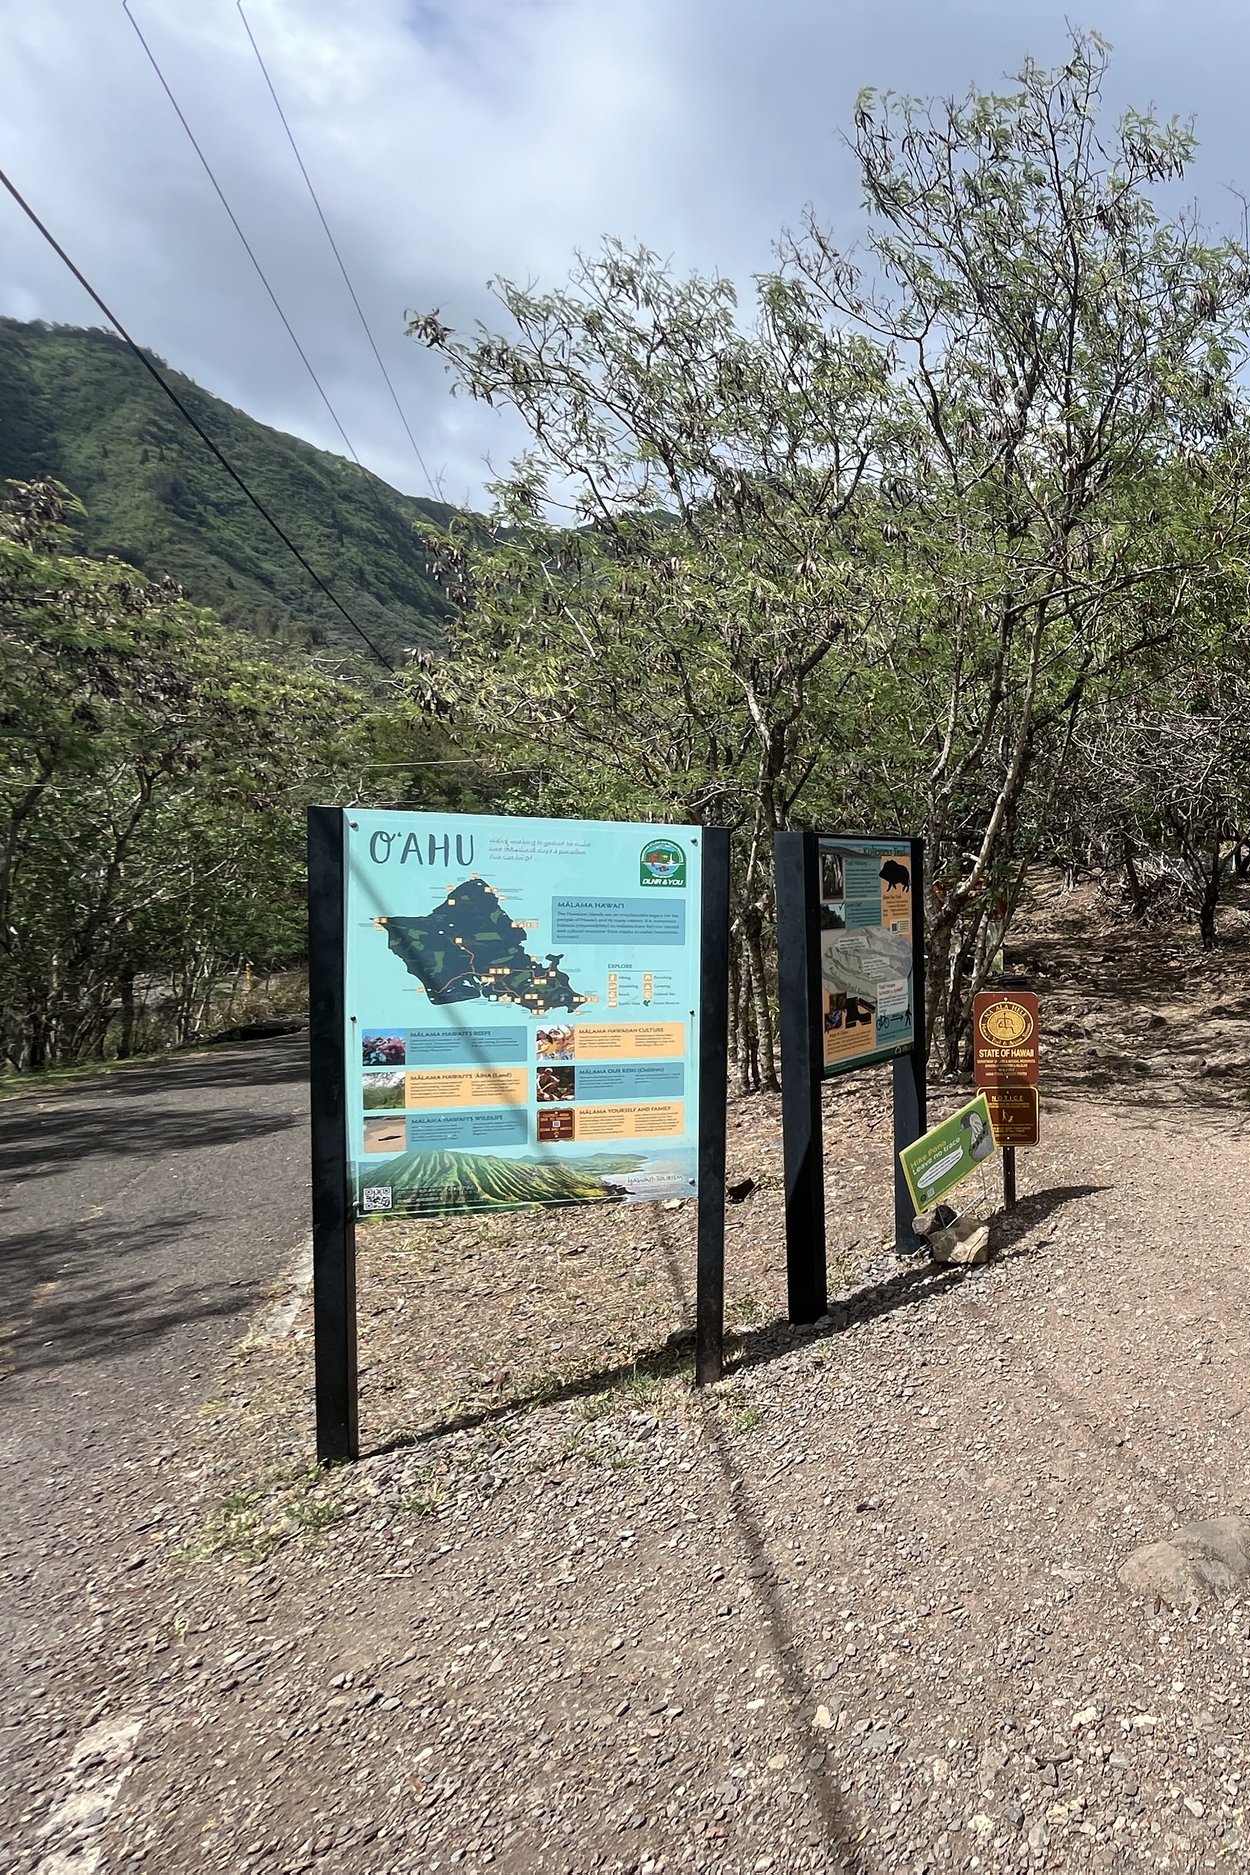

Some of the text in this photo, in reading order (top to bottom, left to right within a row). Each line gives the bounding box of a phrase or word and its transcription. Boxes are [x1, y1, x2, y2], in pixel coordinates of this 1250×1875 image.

[642, 878, 661, 886] DLNR
[979, 1049, 1035, 1058] STATE OF HAWAII
[910, 1140, 947, 1169] Hike Pono
[912, 1137, 961, 1176] Leave no trace
